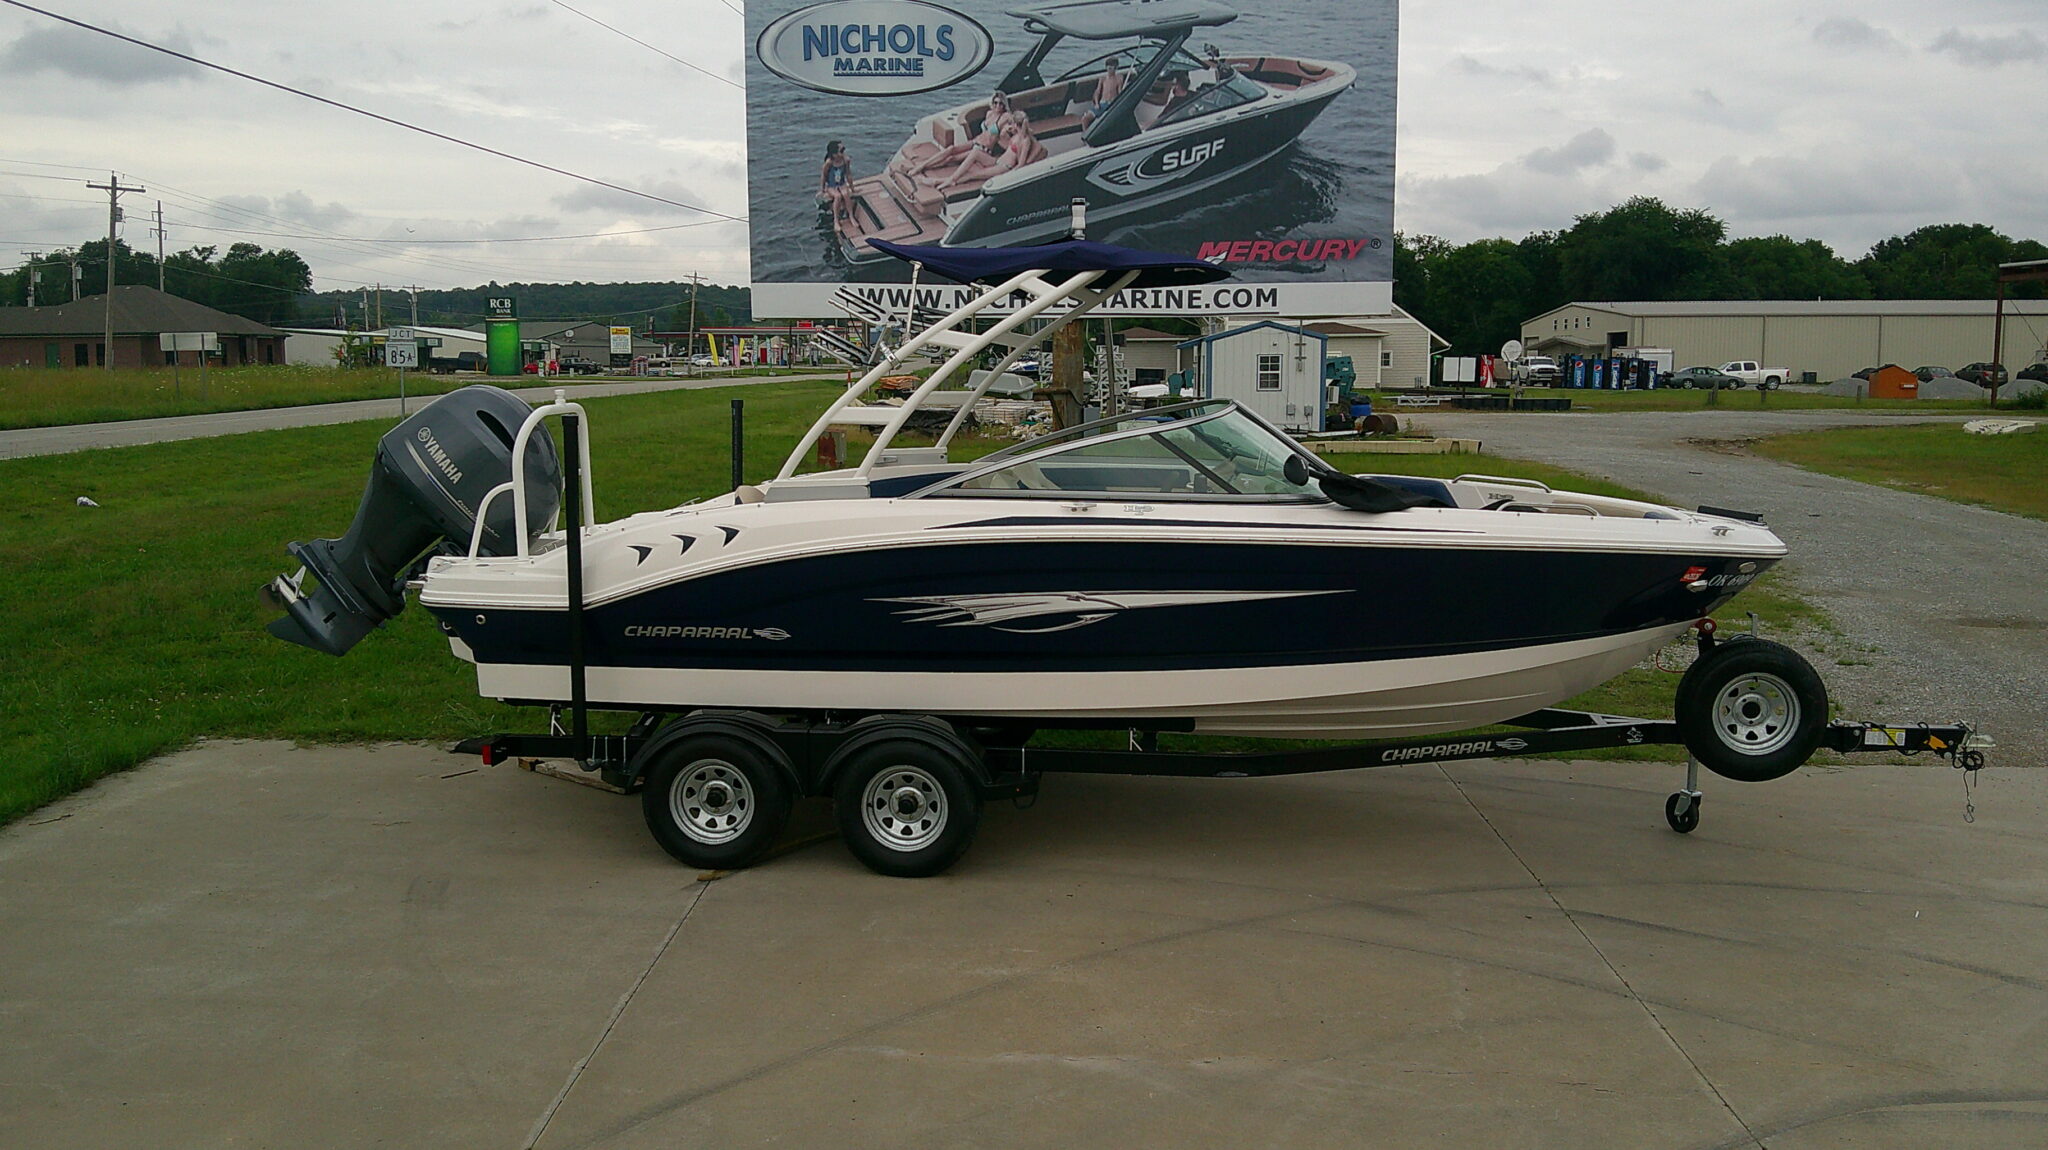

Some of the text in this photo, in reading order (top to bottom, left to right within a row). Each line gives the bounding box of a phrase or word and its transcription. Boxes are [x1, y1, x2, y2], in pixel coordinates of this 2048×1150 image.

[802, 24, 955, 61] NICHOLS
[833, 57, 924, 72] MARINE
[1161, 138, 1226, 171] SURF
[1196, 239, 1369, 262] MERCURY
[490, 298, 512, 309] RCB
[858, 286, 1278, 309] WWW.NCHSARINE.COM
[392, 330, 412, 338] JCT
[391, 350, 413, 364] 85A
[424, 436, 463, 485] YAMAHA
[1708, 575, 1732, 587] OK
[624, 625, 752, 639] CHAPARRAL
[1381, 740, 1495, 762] CHAPARRAL
